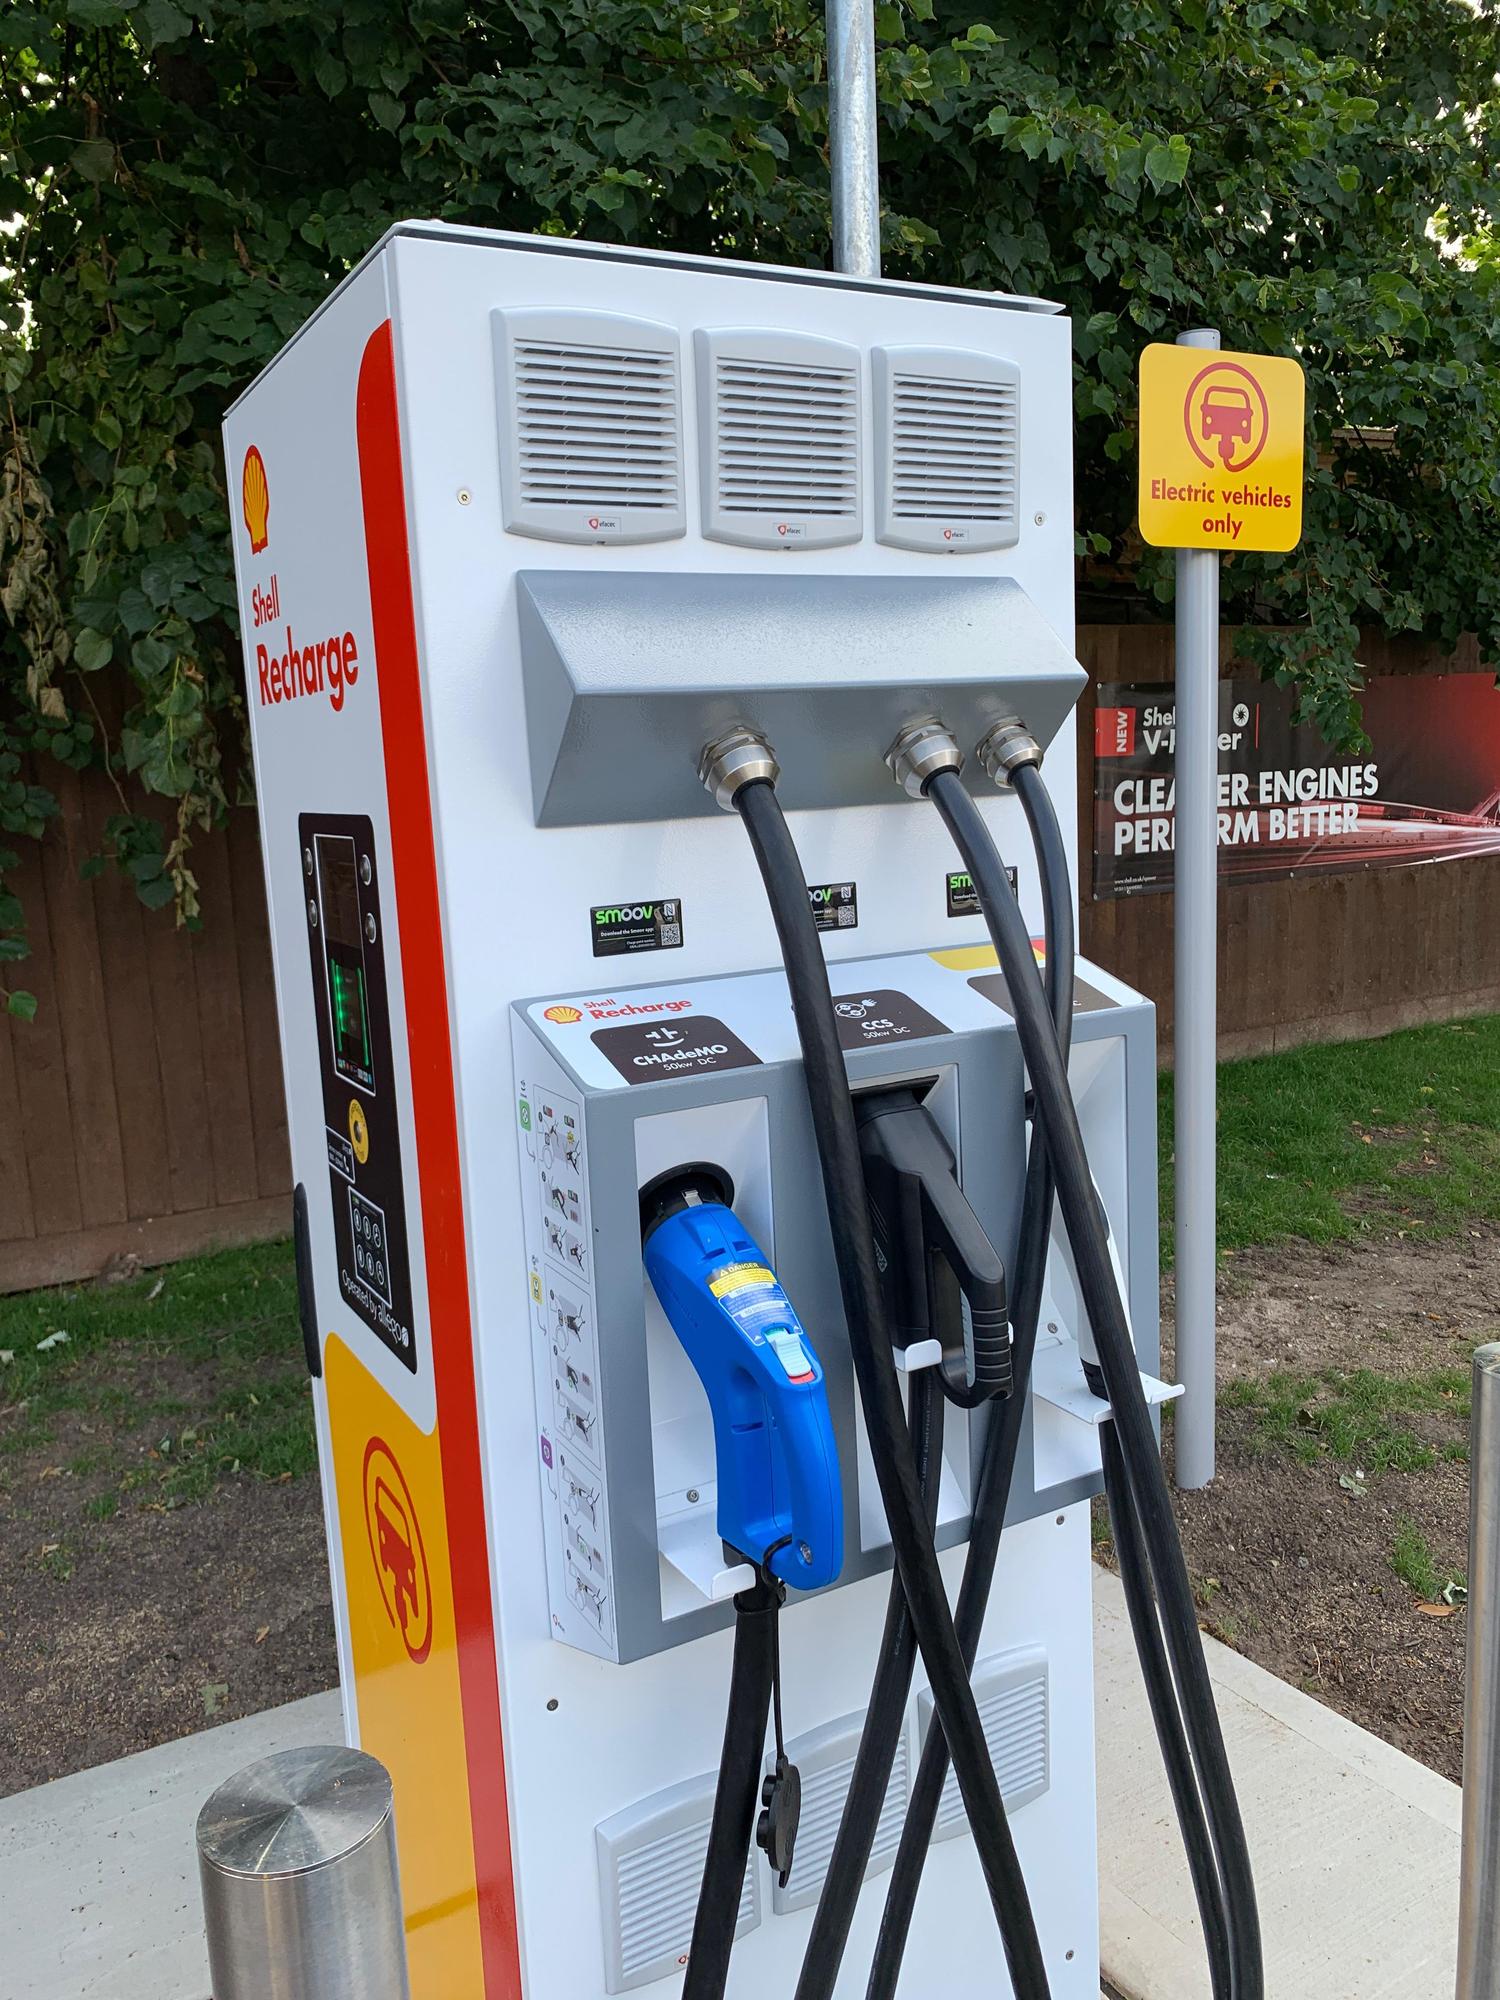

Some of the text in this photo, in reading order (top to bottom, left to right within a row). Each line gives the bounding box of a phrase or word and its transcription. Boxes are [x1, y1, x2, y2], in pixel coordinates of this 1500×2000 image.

[1151, 478, 1292, 508] Electric vehicles
[1202, 512, 1243, 540] only
[252, 573, 280, 627] Shell
[256, 625, 359, 712] Recharge
[1143, 706, 1176, 727] Shel
[1116, 711, 1128, 753] NEW
[1258, 764, 1379, 805] ENGINES
[1114, 802, 1360, 856] PERRM BETTER
[595, 905, 653, 925] smoov
[583, 998, 617, 1009] Shell
[589, 999, 693, 1020] Recharge
[861, 1018, 895, 1030] CCS
[894, 1026, 911, 1035] DC
[633, 1044, 729, 1067] CHAdeMO
[698, 1056, 717, 1066] DC
[727, 1262, 760, 1274] DANGER
[342, 1269, 369, 1308] Operated
[369, 1293, 377, 1320] by
